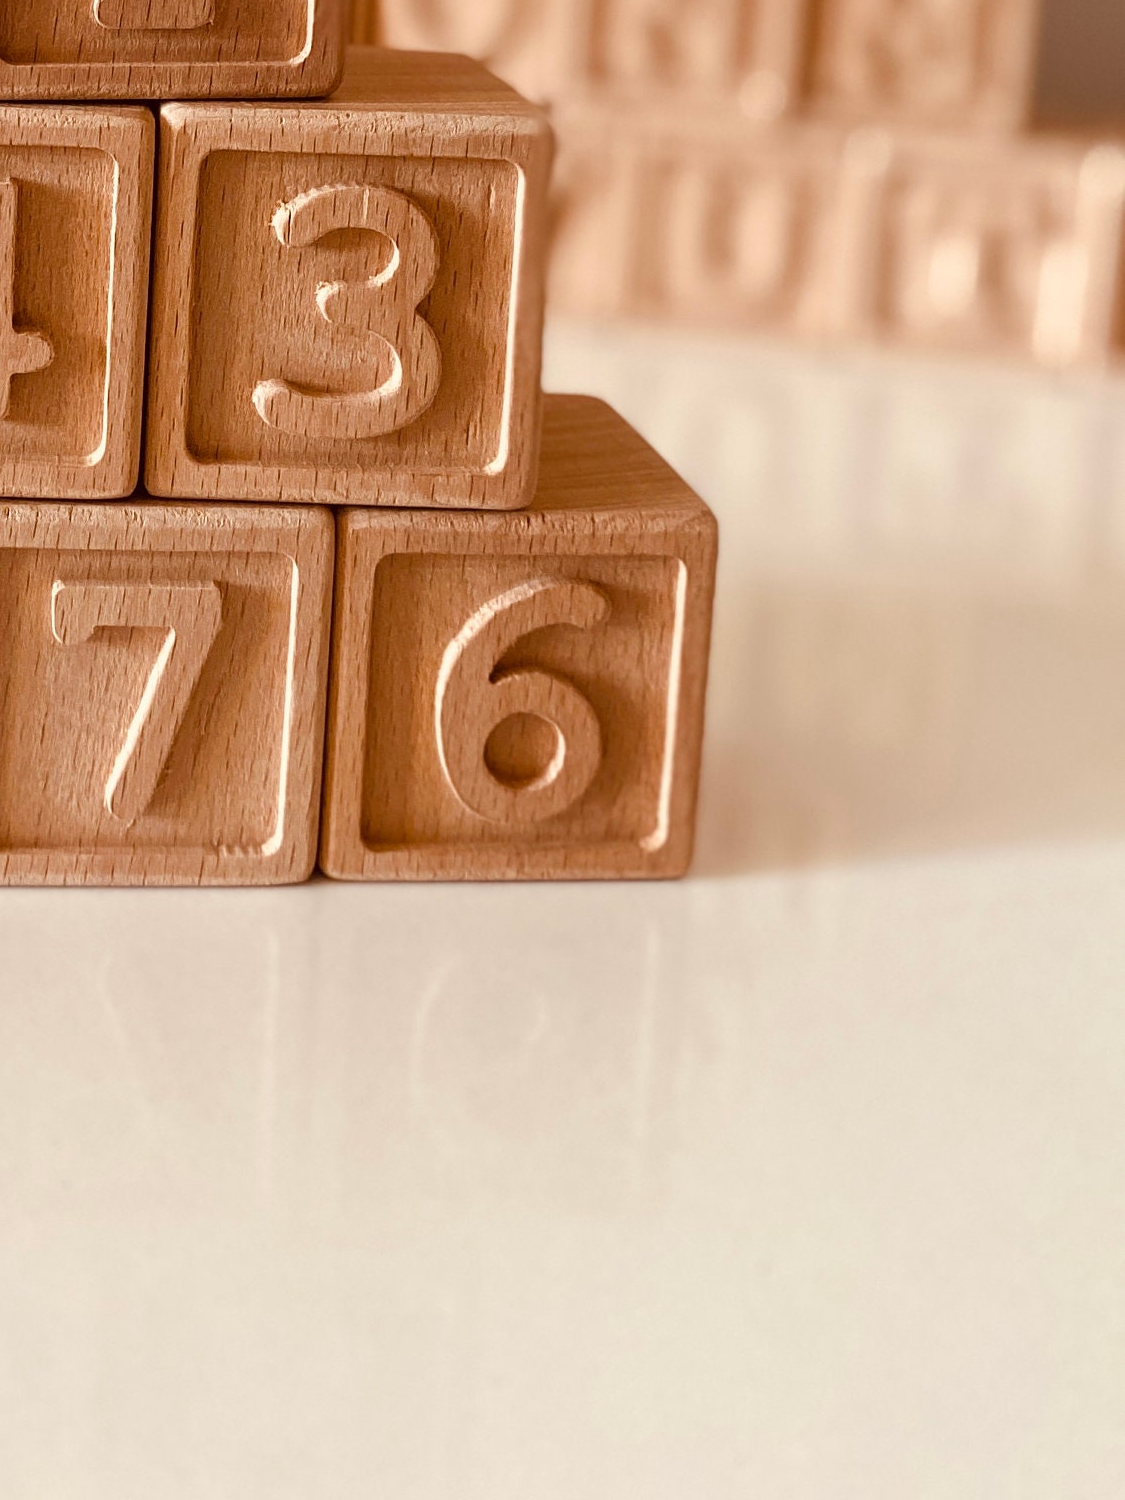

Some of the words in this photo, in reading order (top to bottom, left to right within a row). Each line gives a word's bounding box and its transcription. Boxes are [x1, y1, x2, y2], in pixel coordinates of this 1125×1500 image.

[251, 183, 442, 439] 3
[50, 578, 225, 821] 7
[433, 575, 612, 825] 6
